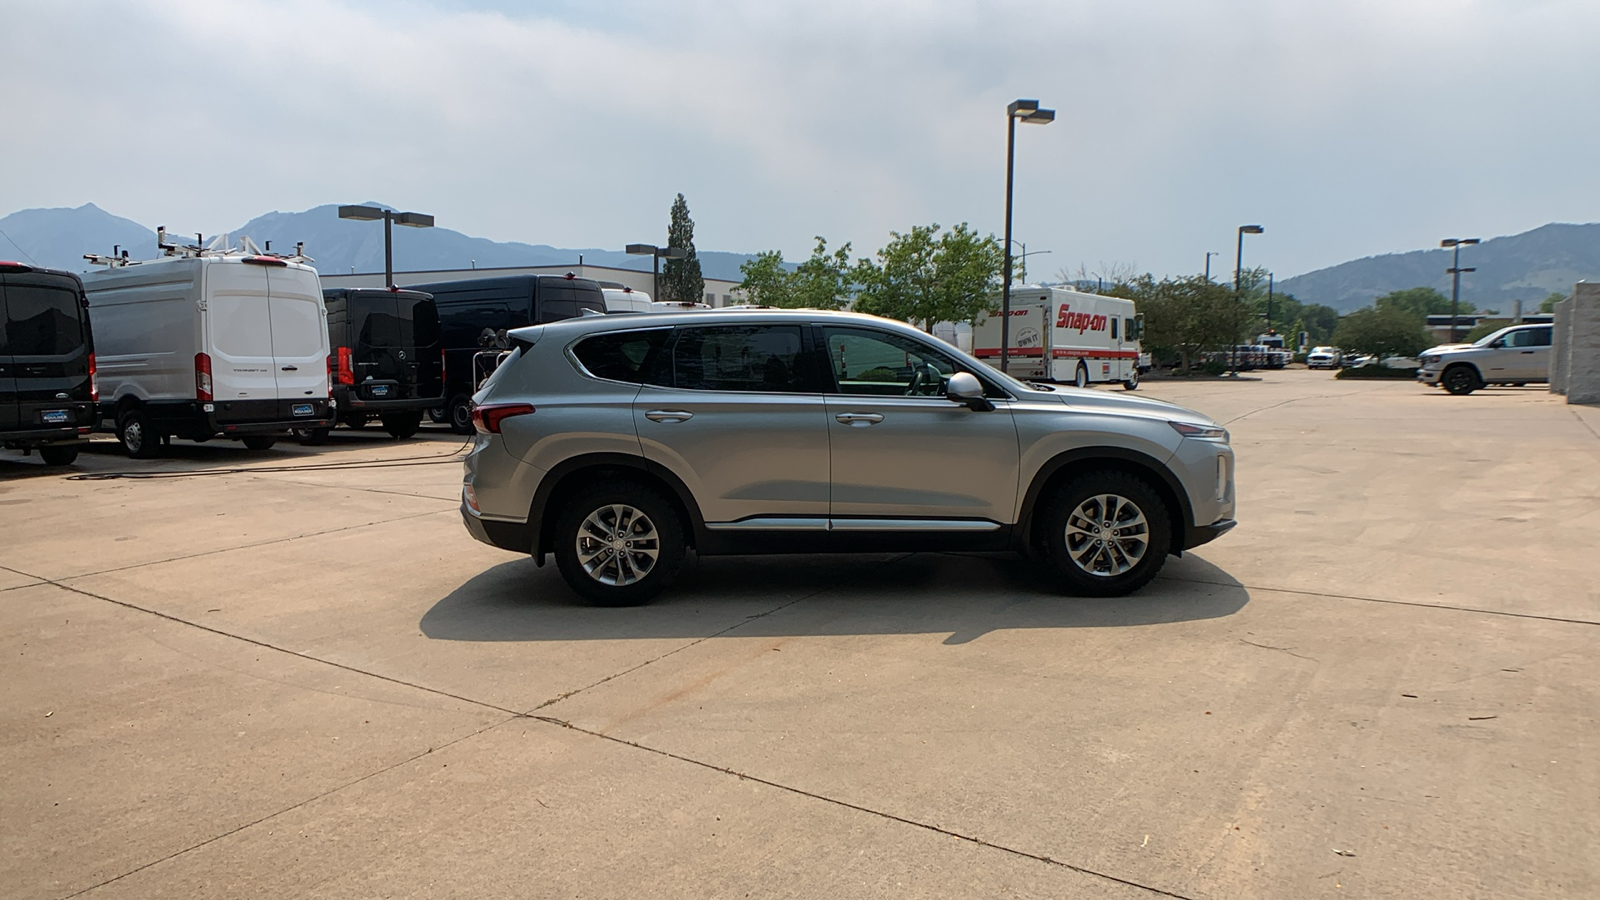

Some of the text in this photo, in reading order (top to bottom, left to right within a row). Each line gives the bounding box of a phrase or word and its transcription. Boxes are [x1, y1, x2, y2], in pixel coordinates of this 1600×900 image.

[1056, 304, 1107, 335] Snap-on
[1018, 336, 1032, 347] OWN
[1032, 333, 1039, 342] IT
